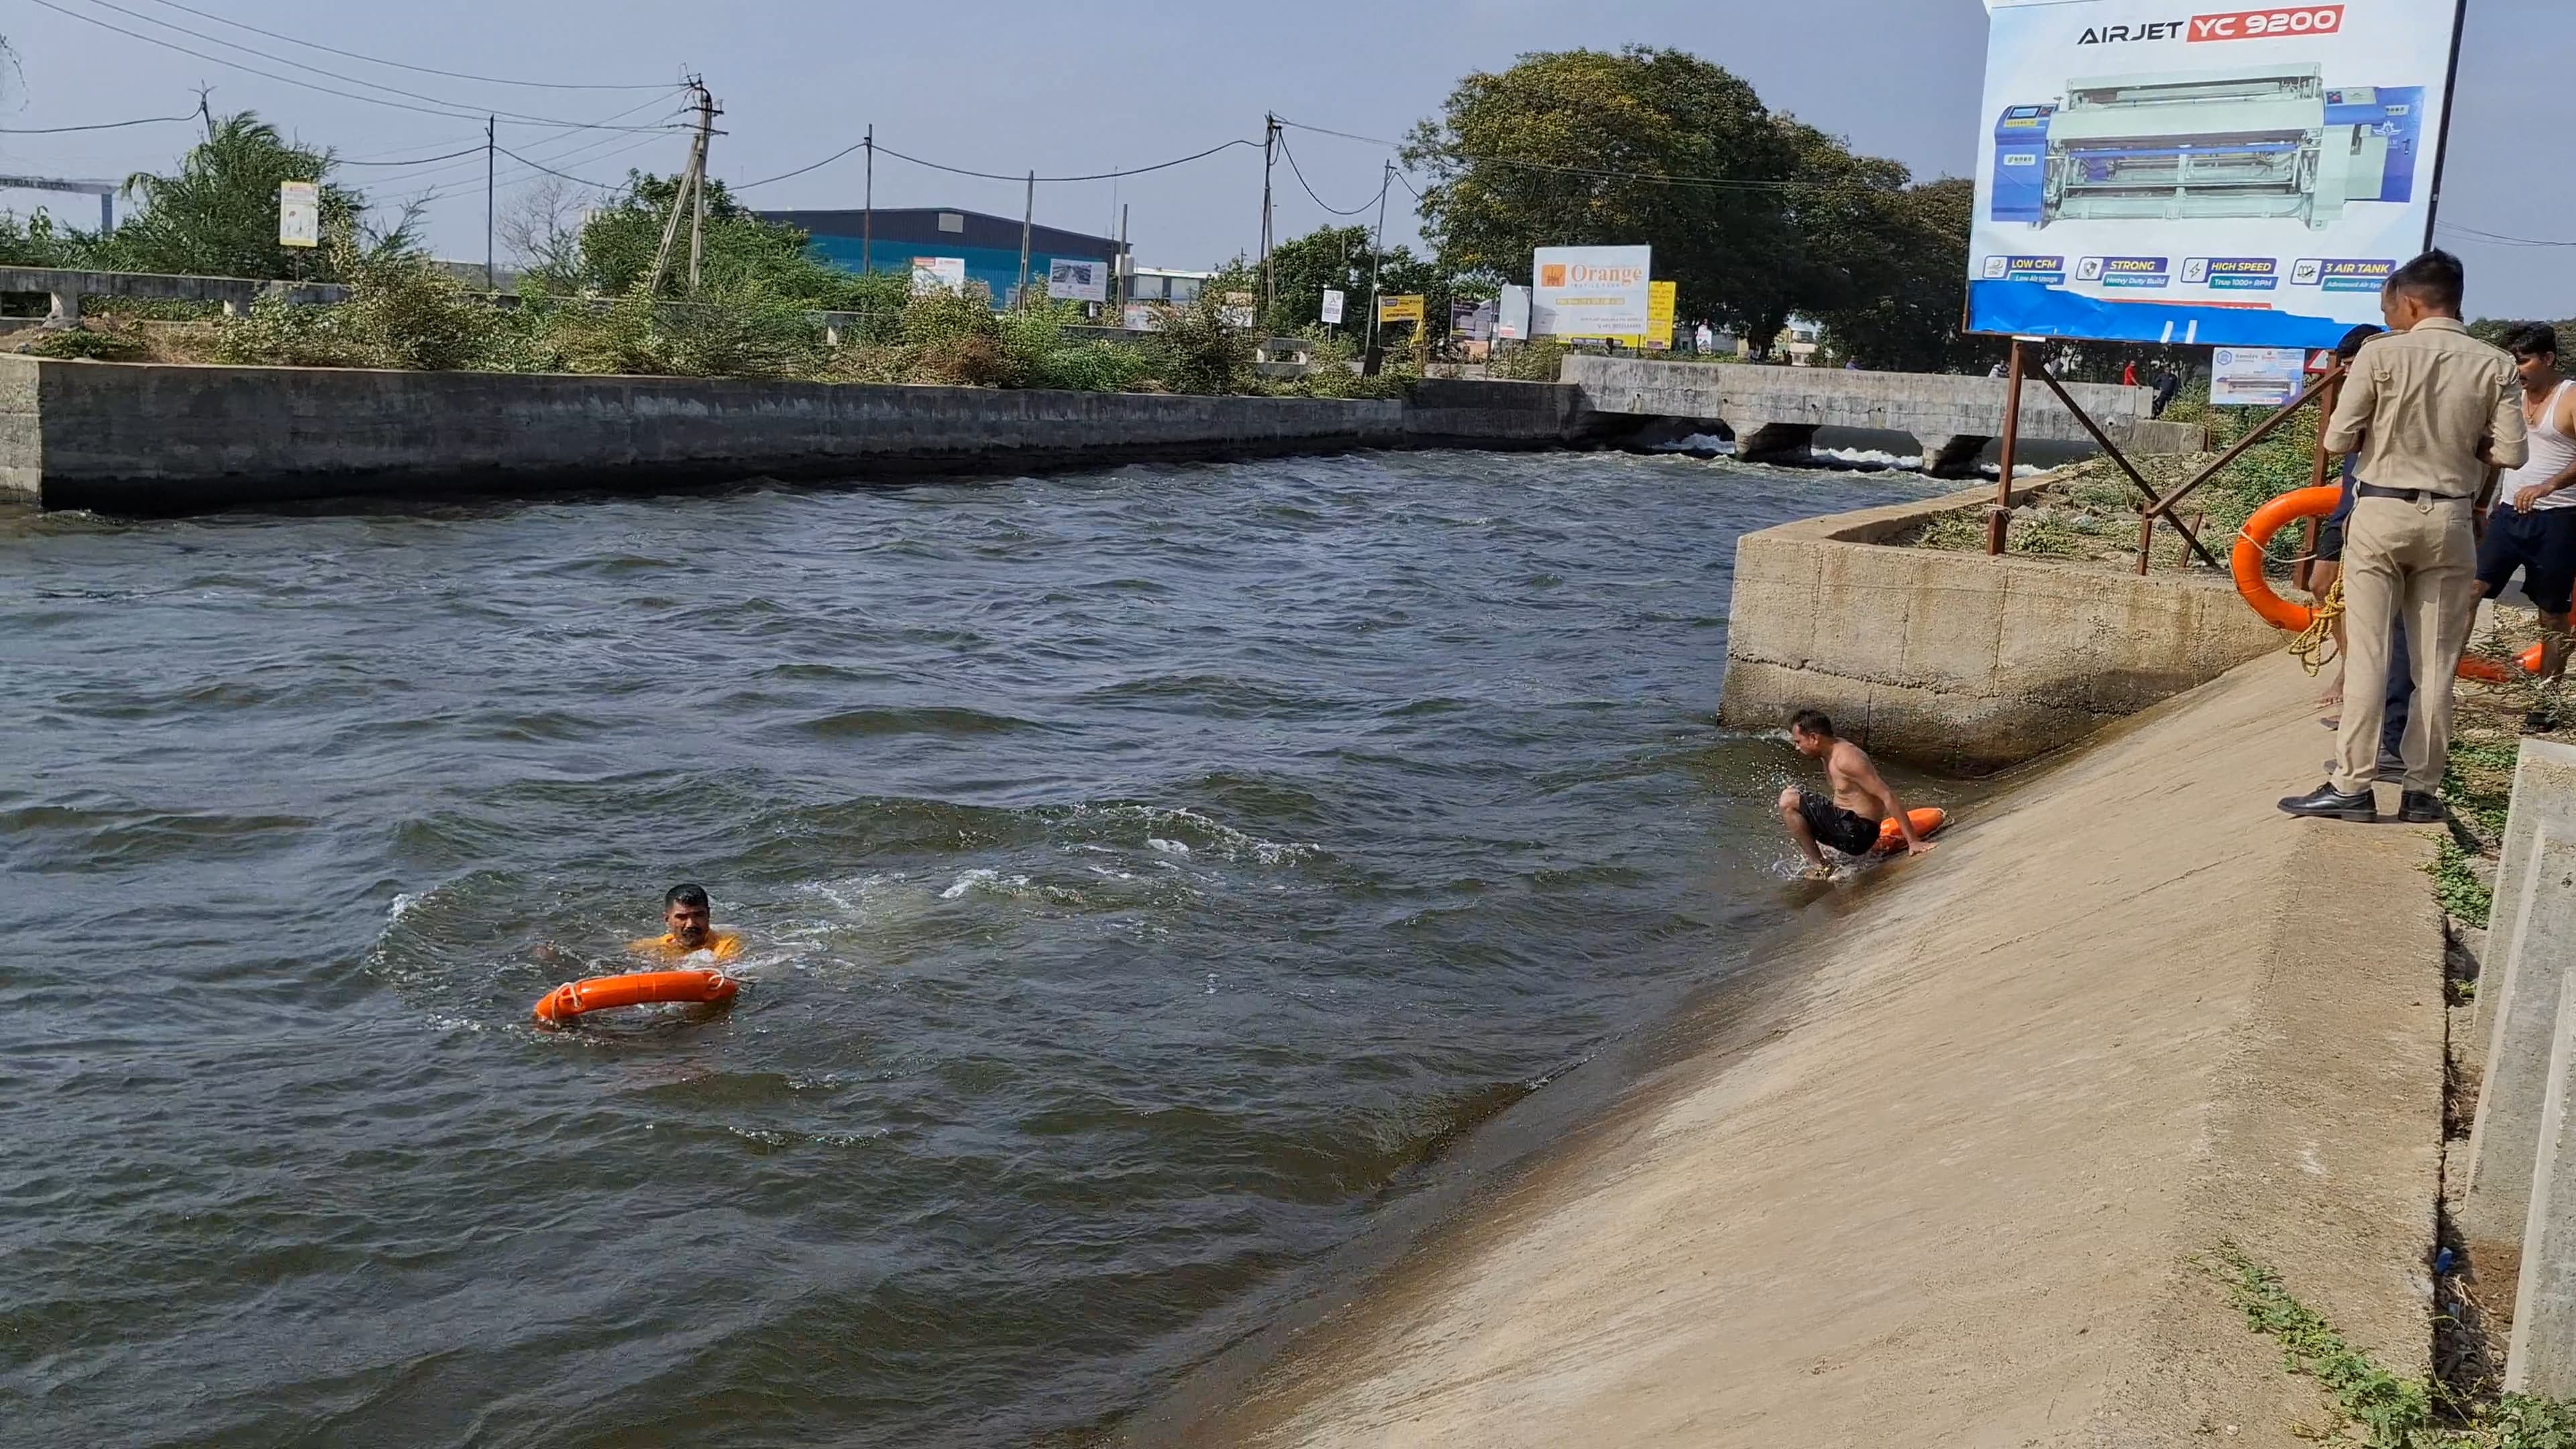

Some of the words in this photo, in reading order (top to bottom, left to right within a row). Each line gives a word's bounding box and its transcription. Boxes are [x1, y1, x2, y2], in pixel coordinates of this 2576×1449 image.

[2076, 21, 2185, 45] AIRJET
[2193, 16, 2238, 38] YC
[2244, 10, 2337, 34] 9200
[2011, 260, 2034, 269] LOW
[2035, 259, 2057, 268] CFM
[2109, 261, 2156, 270] STRONG
[2211, 262, 2237, 272] HIGH
[2238, 262, 2272, 272] SPEED
[2324, 263, 2332, 273] 3
[2333, 263, 2356, 274] AIR
[2356, 263, 2390, 274] TANK
[1570, 264, 1642, 285] Orange
[2106, 277, 2127, 285] Heavy
[2129, 278, 2146, 286] Duty
[2232, 278, 2253, 286] 1000+
[2254, 279, 2273, 287] RPM
